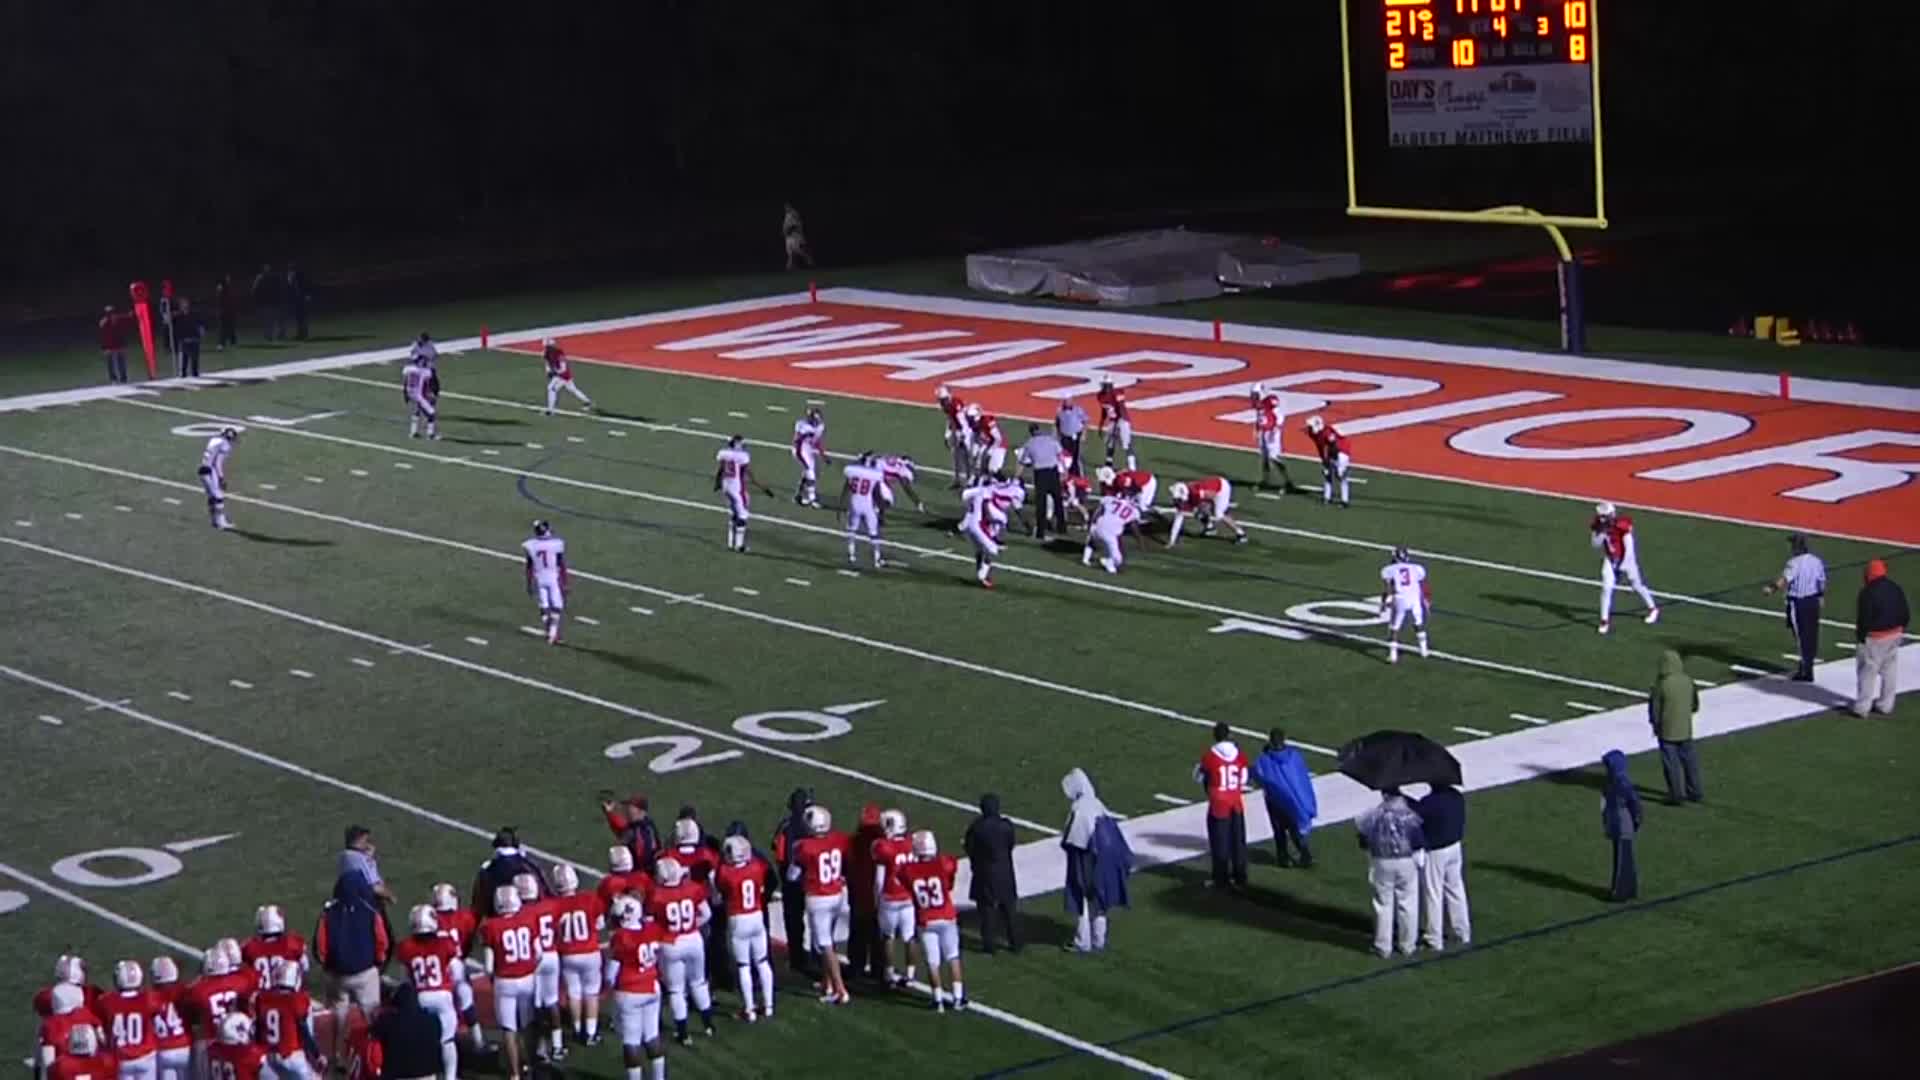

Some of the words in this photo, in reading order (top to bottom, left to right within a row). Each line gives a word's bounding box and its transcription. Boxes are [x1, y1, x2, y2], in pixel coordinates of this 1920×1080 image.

[1386, 9, 1417, 36] 21
[1493, 16, 1507, 38] 4
[1537, 16, 1549, 36] 3
[1563, 1, 1587, 28] 10
[1389, 42, 1405, 69] 2
[1452, 39, 1475, 66] 10
[1569, 34, 1586, 61] 8
[1111, 500, 1133, 520] 70
[536, 549, 548, 569] 7
[1399, 567, 1411, 587] 3
[604, 710, 853, 774] 20
[1218, 765, 1240, 792] 16
[818, 847, 842, 885] 69
[741, 878, 756, 911] 8
[912, 876, 945, 909] 63
[665, 898, 695, 933] 99
[502, 925, 532, 964] 98
[411, 954, 443, 989] 23
[111, 1011, 143, 1048] 40
[265, 1007, 281, 1045] 9
